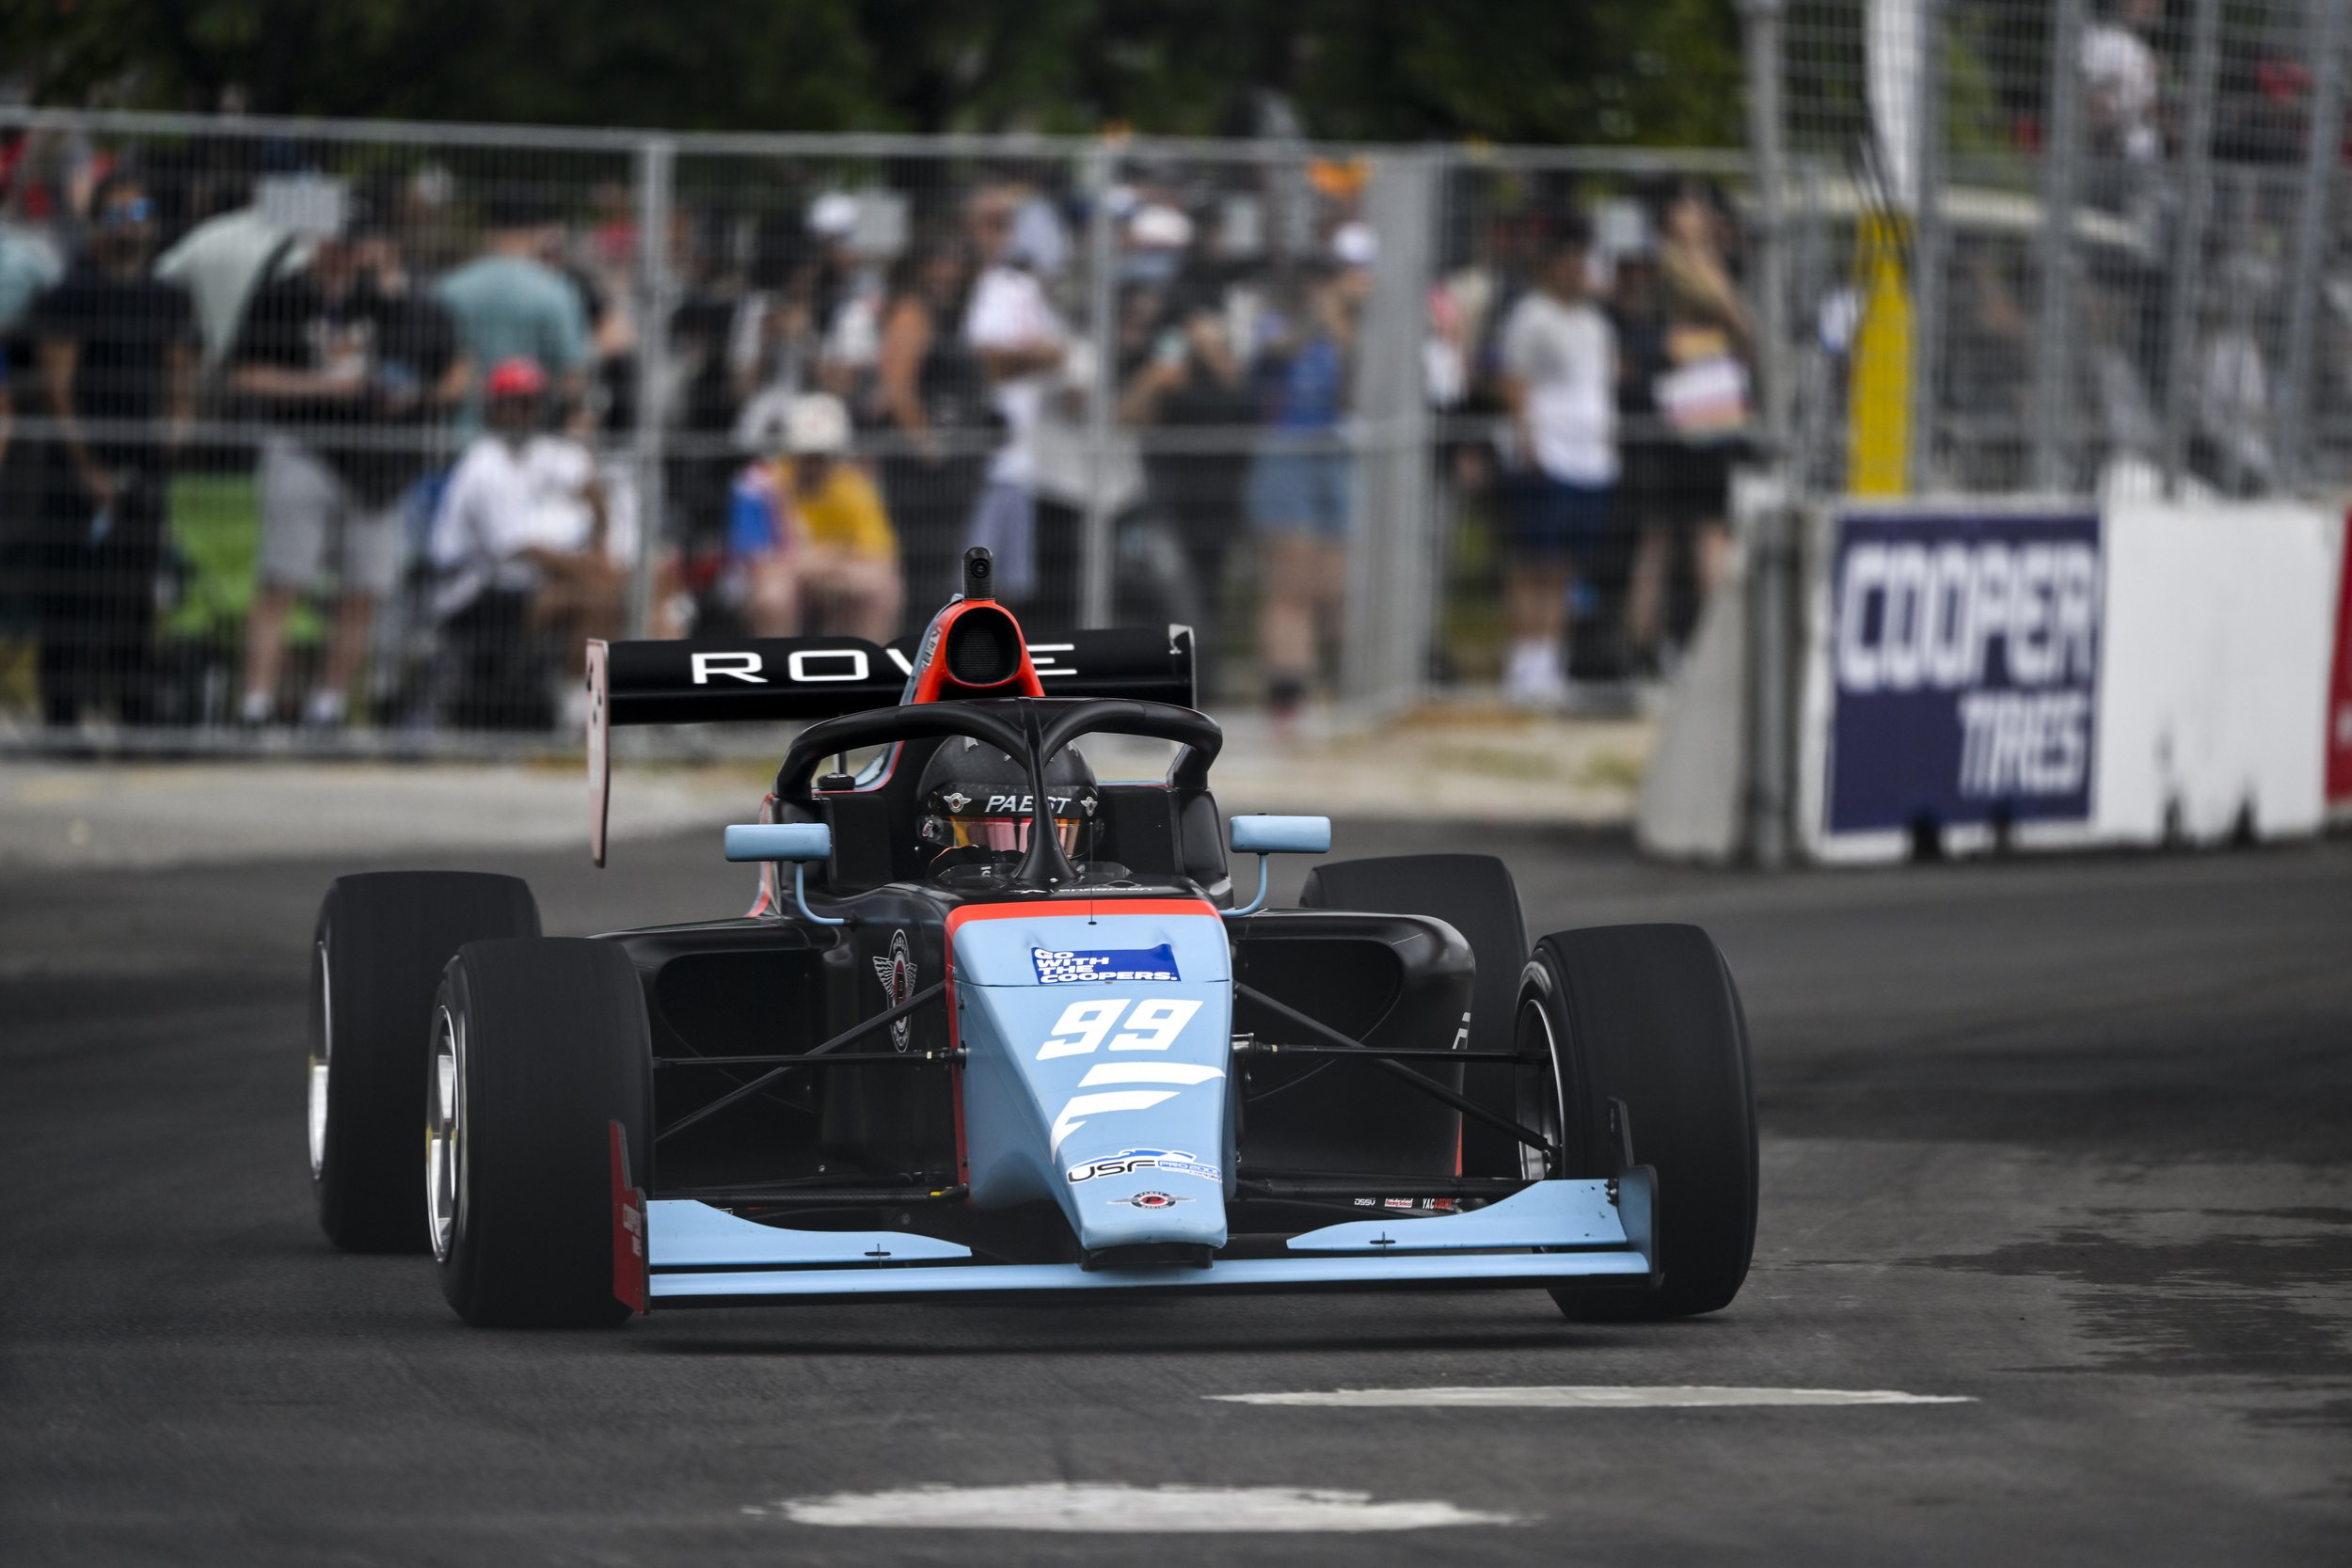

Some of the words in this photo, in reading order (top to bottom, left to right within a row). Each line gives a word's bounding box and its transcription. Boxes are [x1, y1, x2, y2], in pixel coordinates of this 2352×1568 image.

[1839, 541, 2096, 692] COOPER
[691, 643, 1077, 685] ROE
[1958, 689, 2089, 797] TIRES
[1034, 948, 1074, 959] GO
[1036, 958, 1109, 968] WITH
[1038, 964, 1094, 975] THE
[1041, 972, 1178, 984] COOPERS.
[1036, 998, 1204, 1061] 99
[1068, 1160, 1155, 1182] USF
